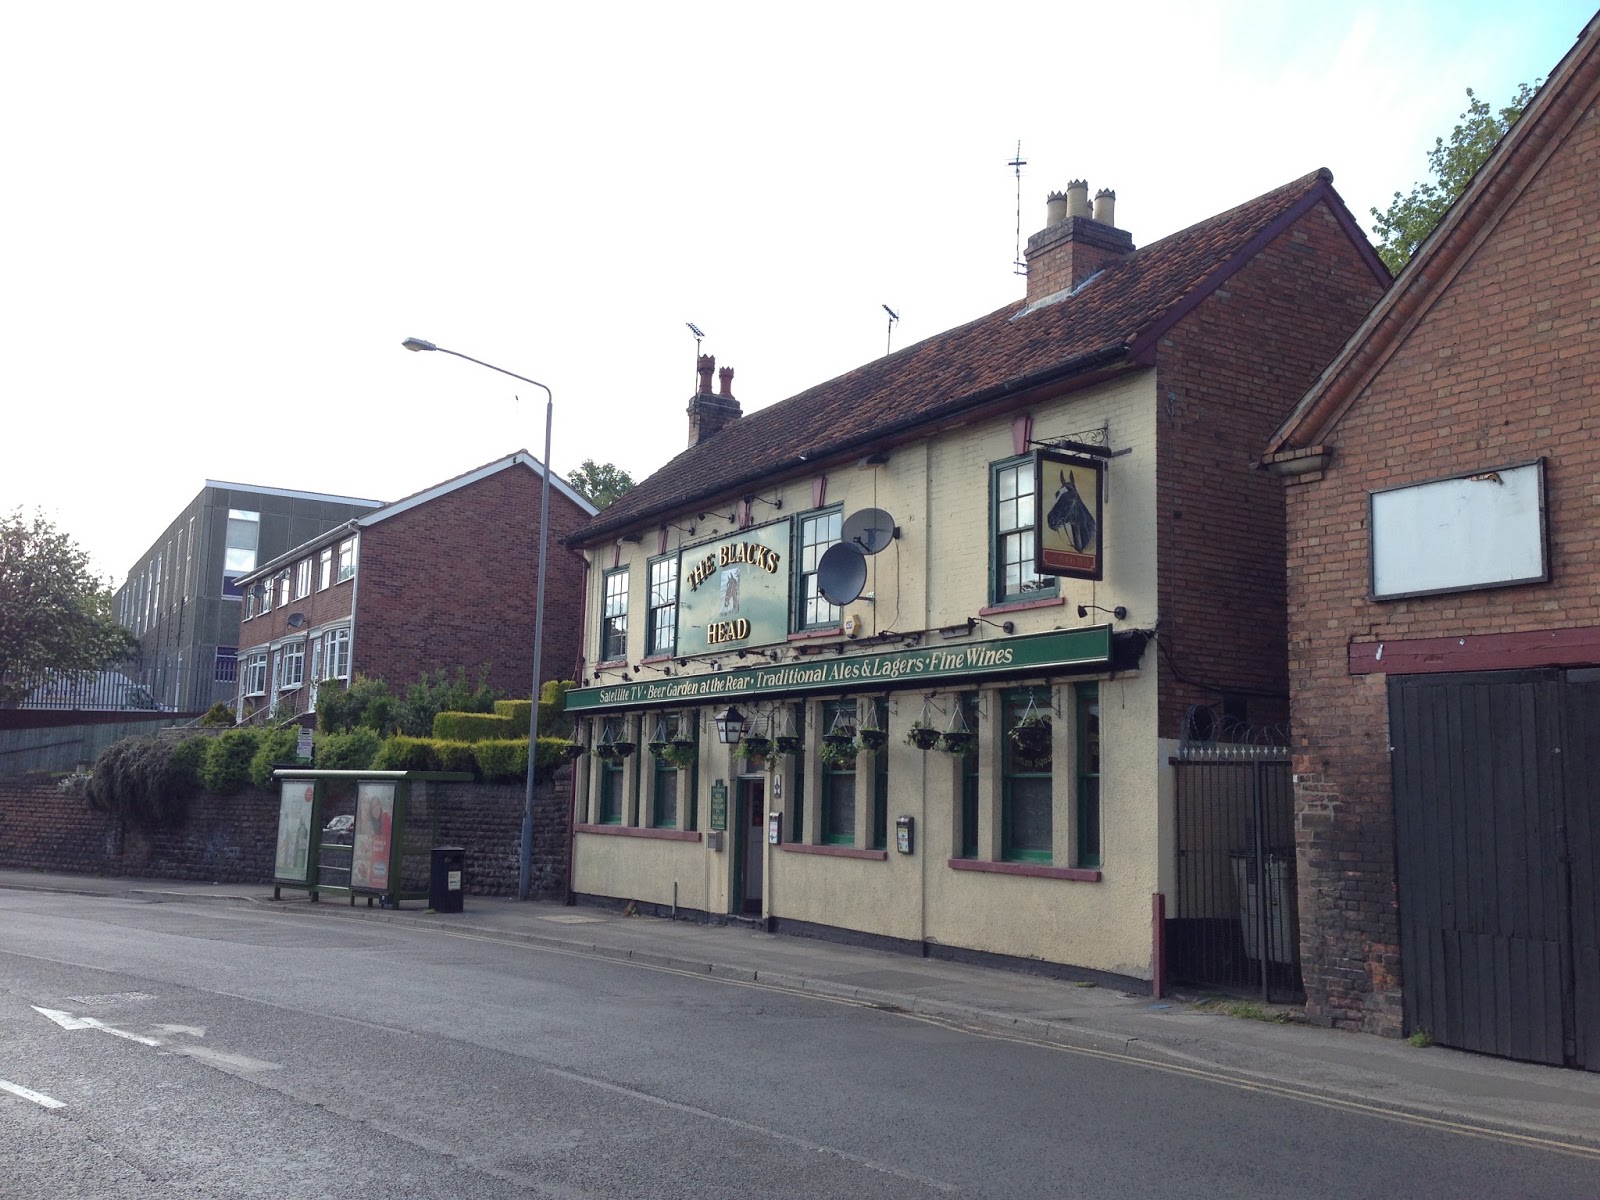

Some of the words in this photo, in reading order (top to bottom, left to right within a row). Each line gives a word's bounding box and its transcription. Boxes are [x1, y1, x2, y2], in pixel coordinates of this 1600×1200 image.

[687, 553, 717, 592] THE
[719, 541, 780, 574] BLACKS
[707, 618, 751, 644] HEAD
[600, 688, 629, 703] Satellite
[631, 686, 644, 700] TV
[647, 685, 666, 699] Beer
[667, 681, 698, 697] Garden
[700, 680, 710, 693] at
[710, 677, 725, 692] the
[725, 675, 750, 691] Rear
[757, 664, 828, 688] Traditional
[829, 662, 860, 680] Ales
[861, 660, 872, 677] &
[872, 658, 924, 678] Lagers
[929, 651, 965, 671] Fine
[966, 647, 1013, 667] Wines
